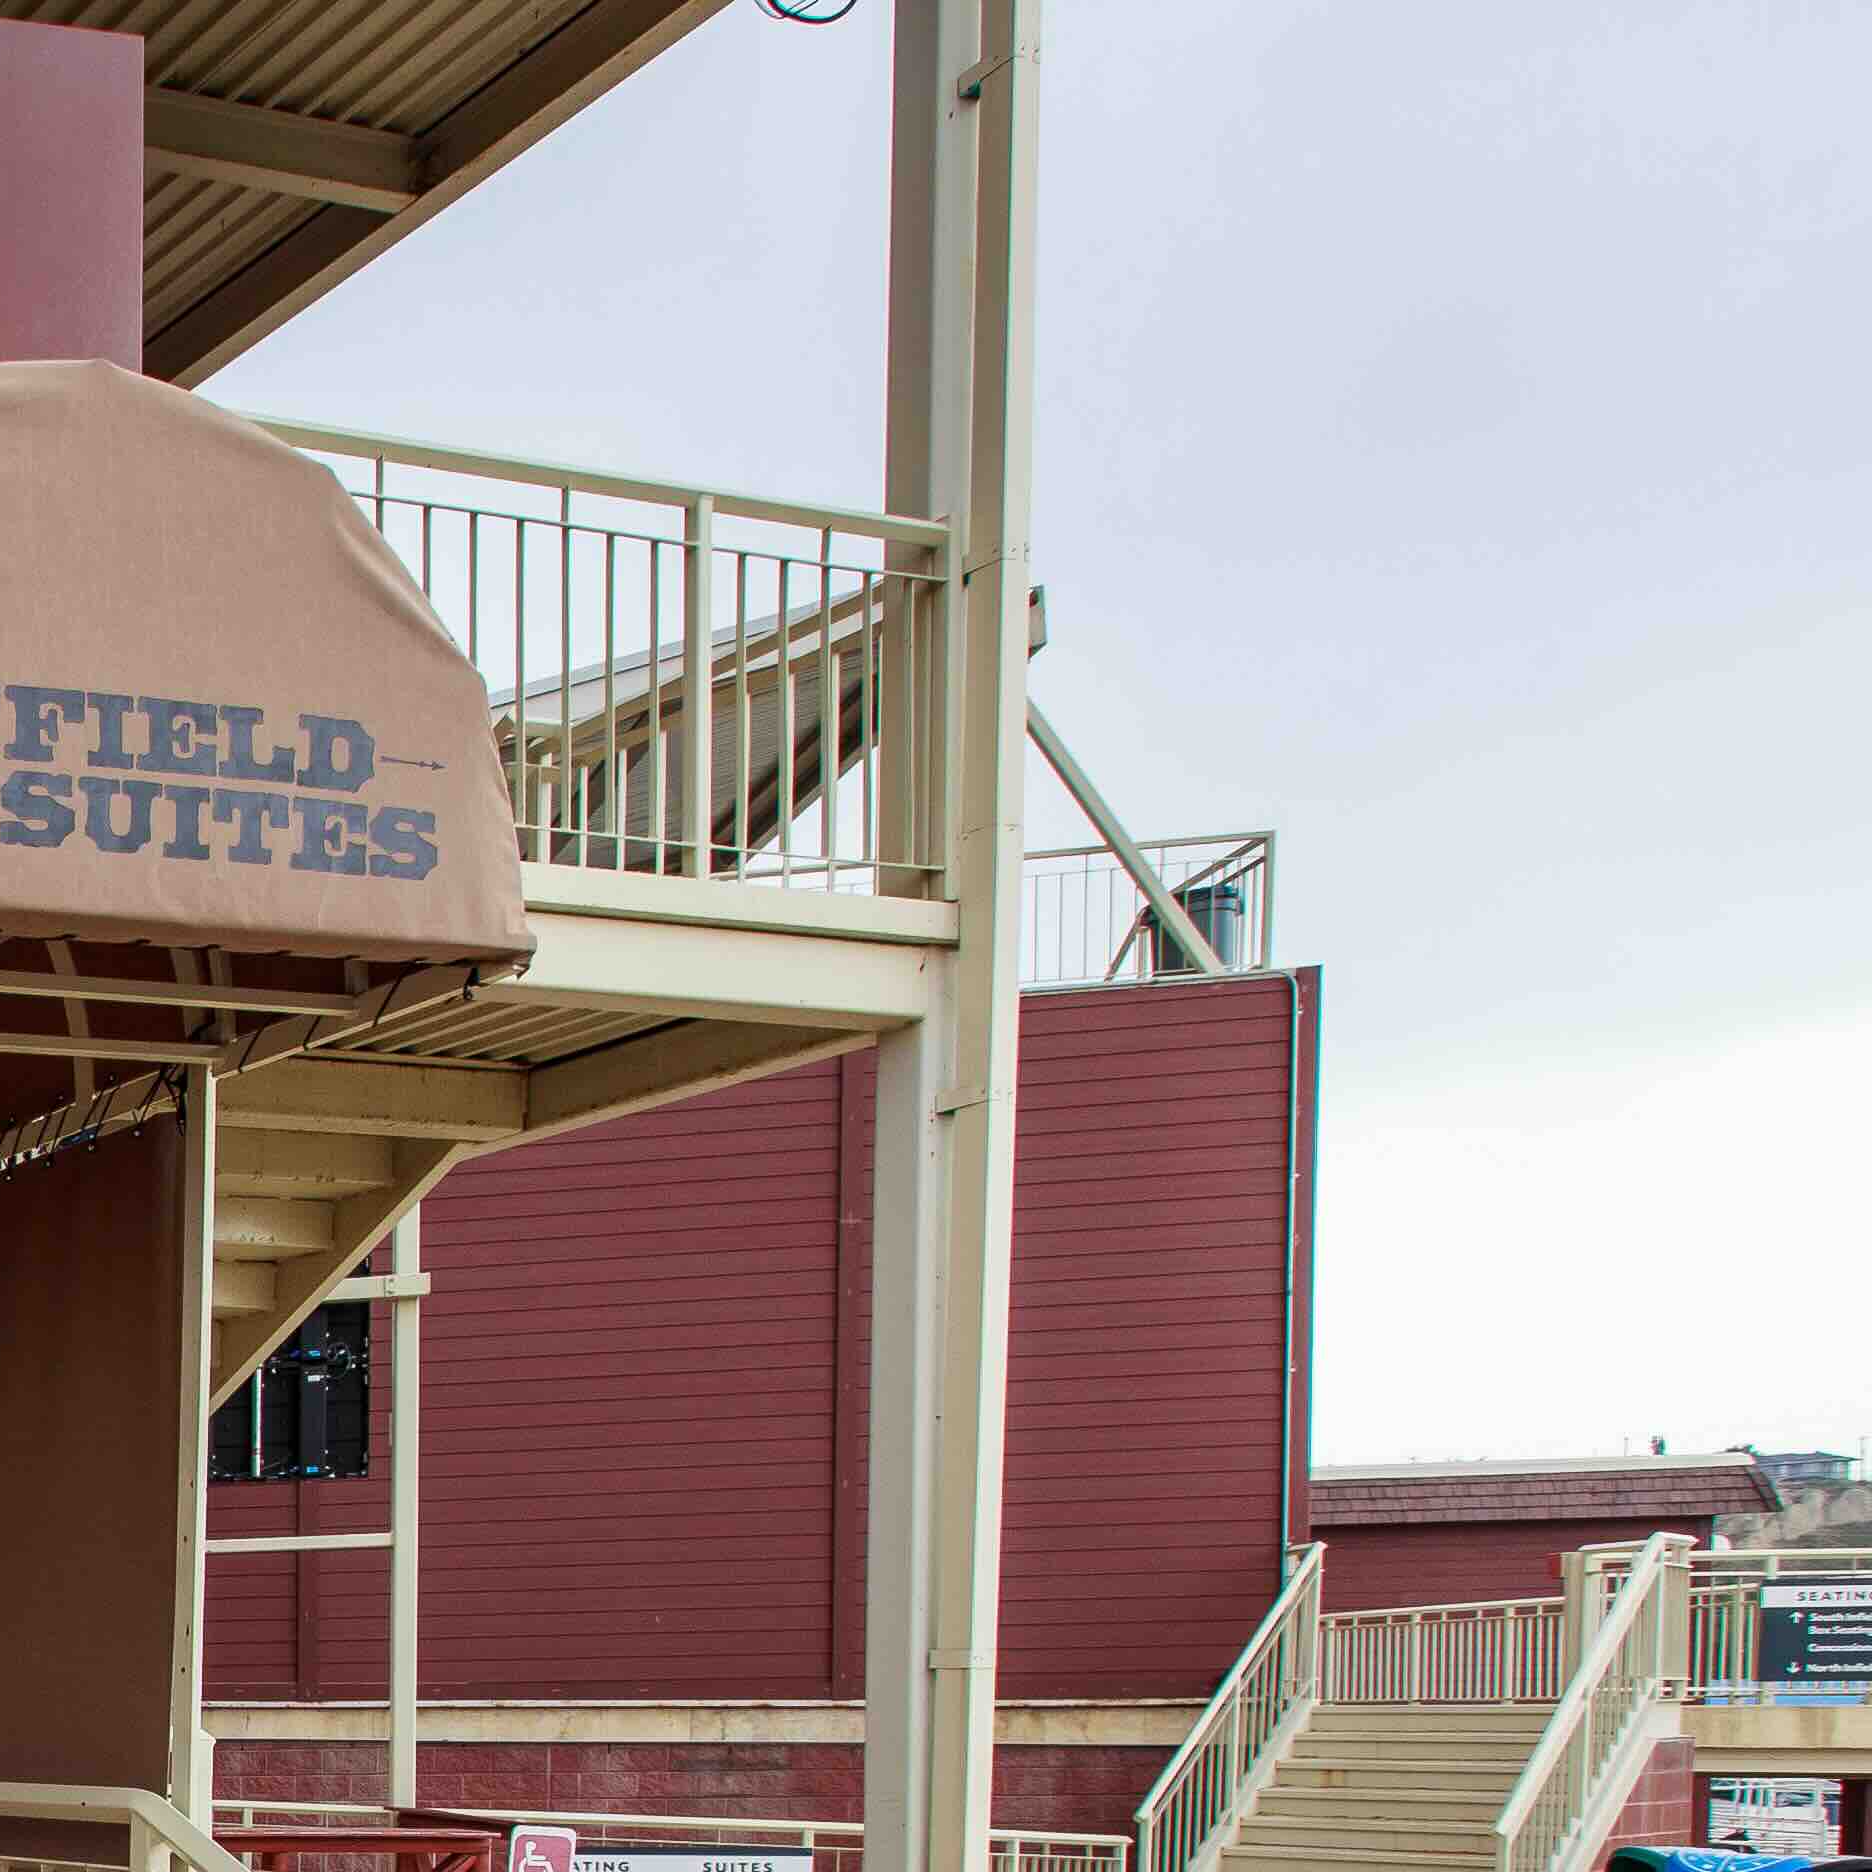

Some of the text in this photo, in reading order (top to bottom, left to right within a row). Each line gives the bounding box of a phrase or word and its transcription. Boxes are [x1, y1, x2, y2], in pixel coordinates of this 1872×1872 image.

[0, 770, 439, 882] SUITES
[573, 1861, 630, 1872] ATING
[703, 1862, 773, 1872] SUITES
